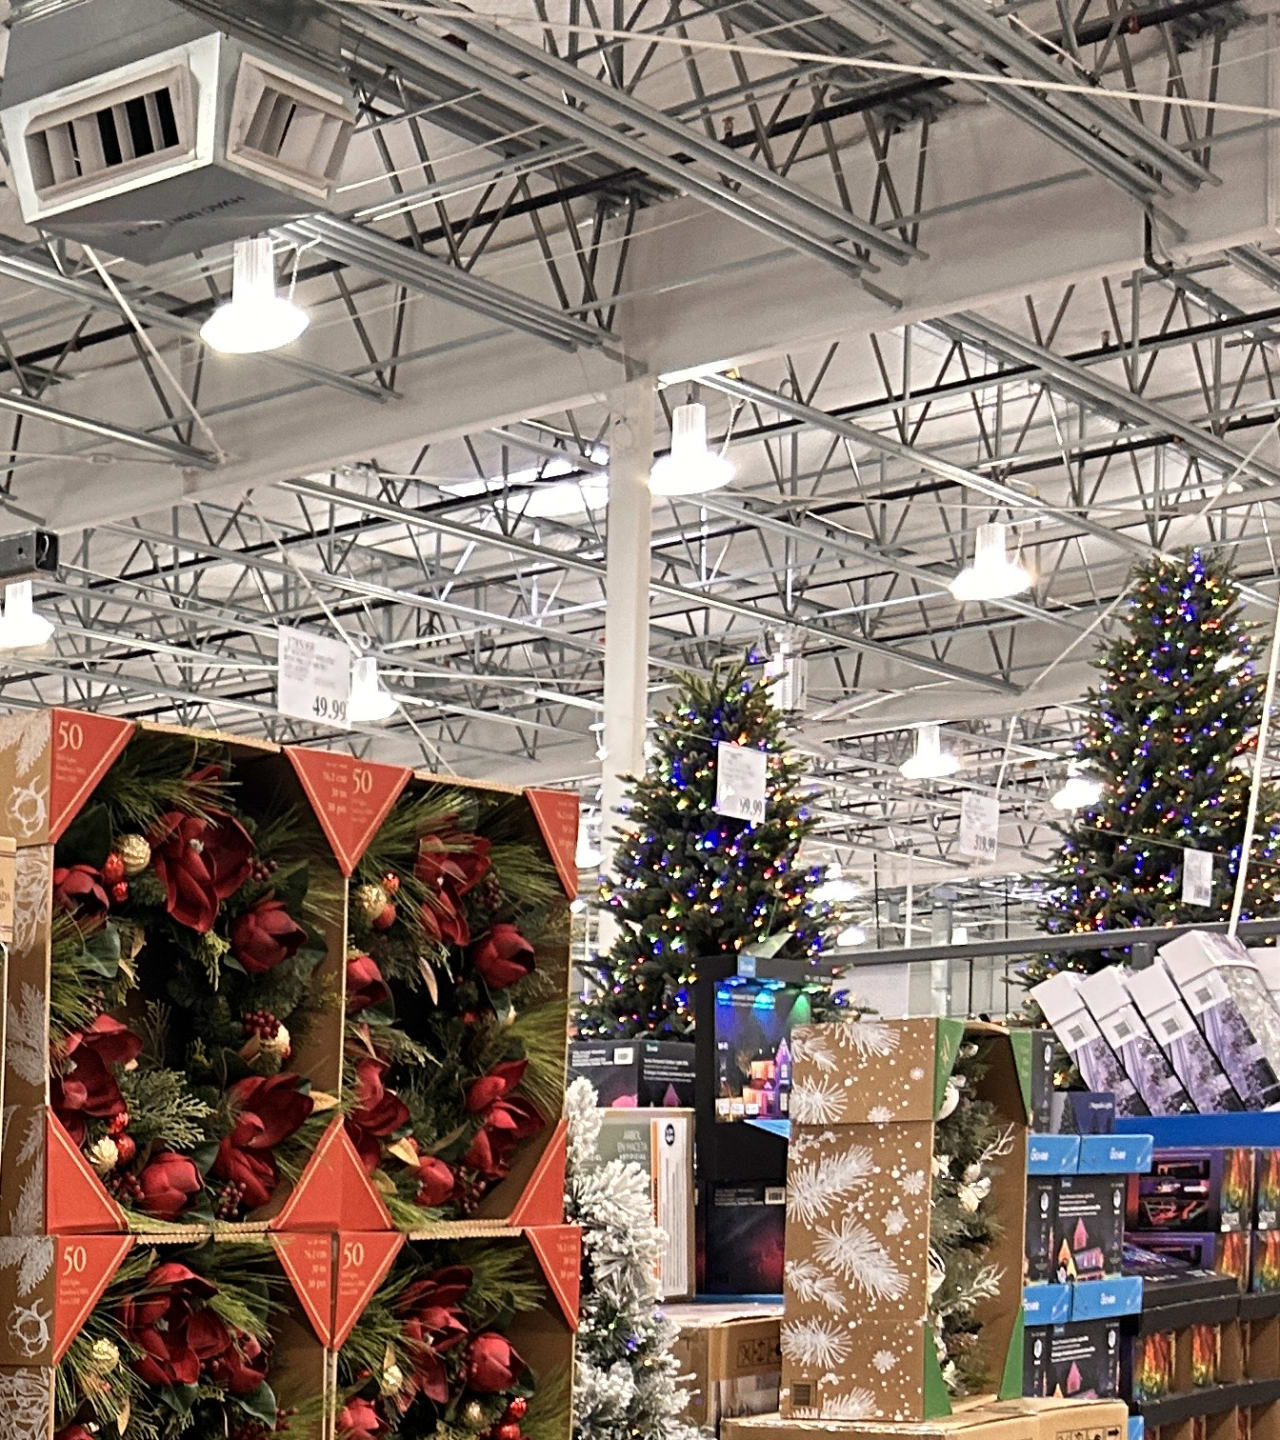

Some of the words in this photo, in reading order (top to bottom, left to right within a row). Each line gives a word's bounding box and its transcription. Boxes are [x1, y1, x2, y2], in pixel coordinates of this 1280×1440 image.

[312, 696, 347, 720] 49.99
[58, 721, 83, 751] 50
[352, 769, 373, 794] 50
[62, 1245, 87, 1277] 50
[342, 1242, 364, 1270] 50
